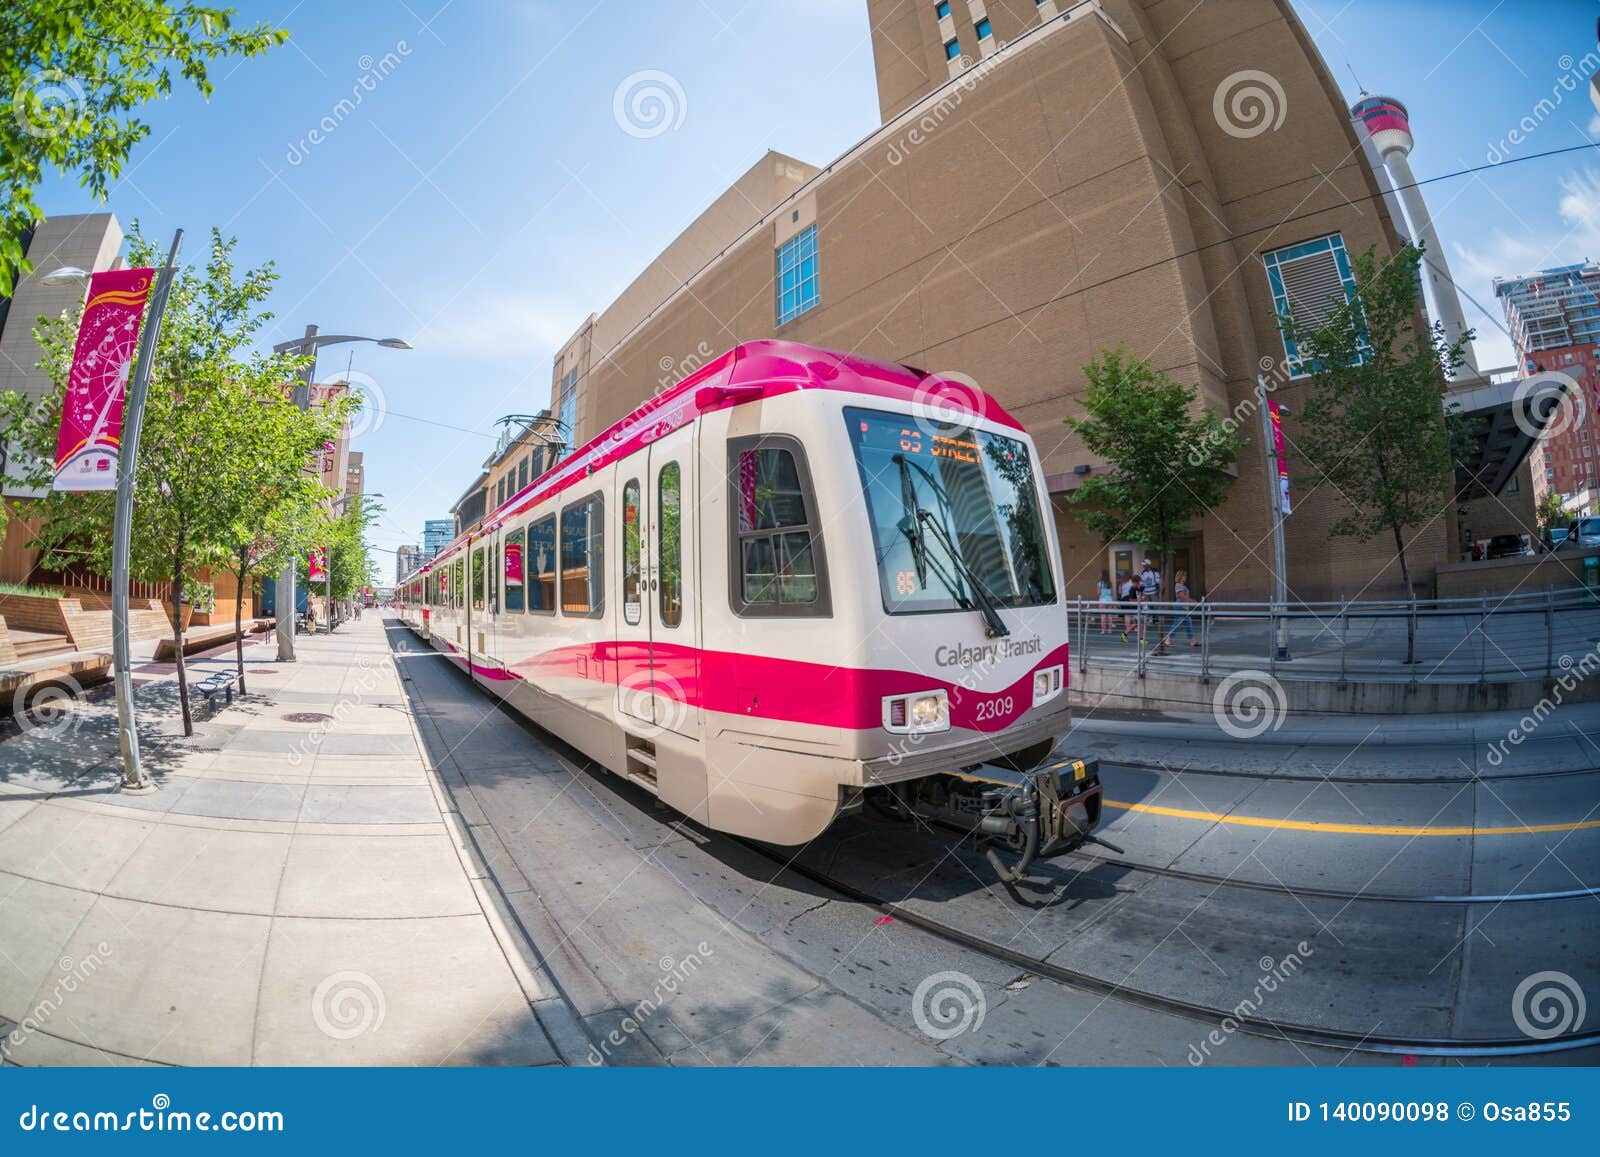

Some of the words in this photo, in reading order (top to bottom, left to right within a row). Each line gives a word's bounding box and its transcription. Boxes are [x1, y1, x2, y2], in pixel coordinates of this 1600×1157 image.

[934, 642, 998, 669] Calgary
[1002, 634, 1041, 658] Transit
[975, 696, 1014, 722] 2309
